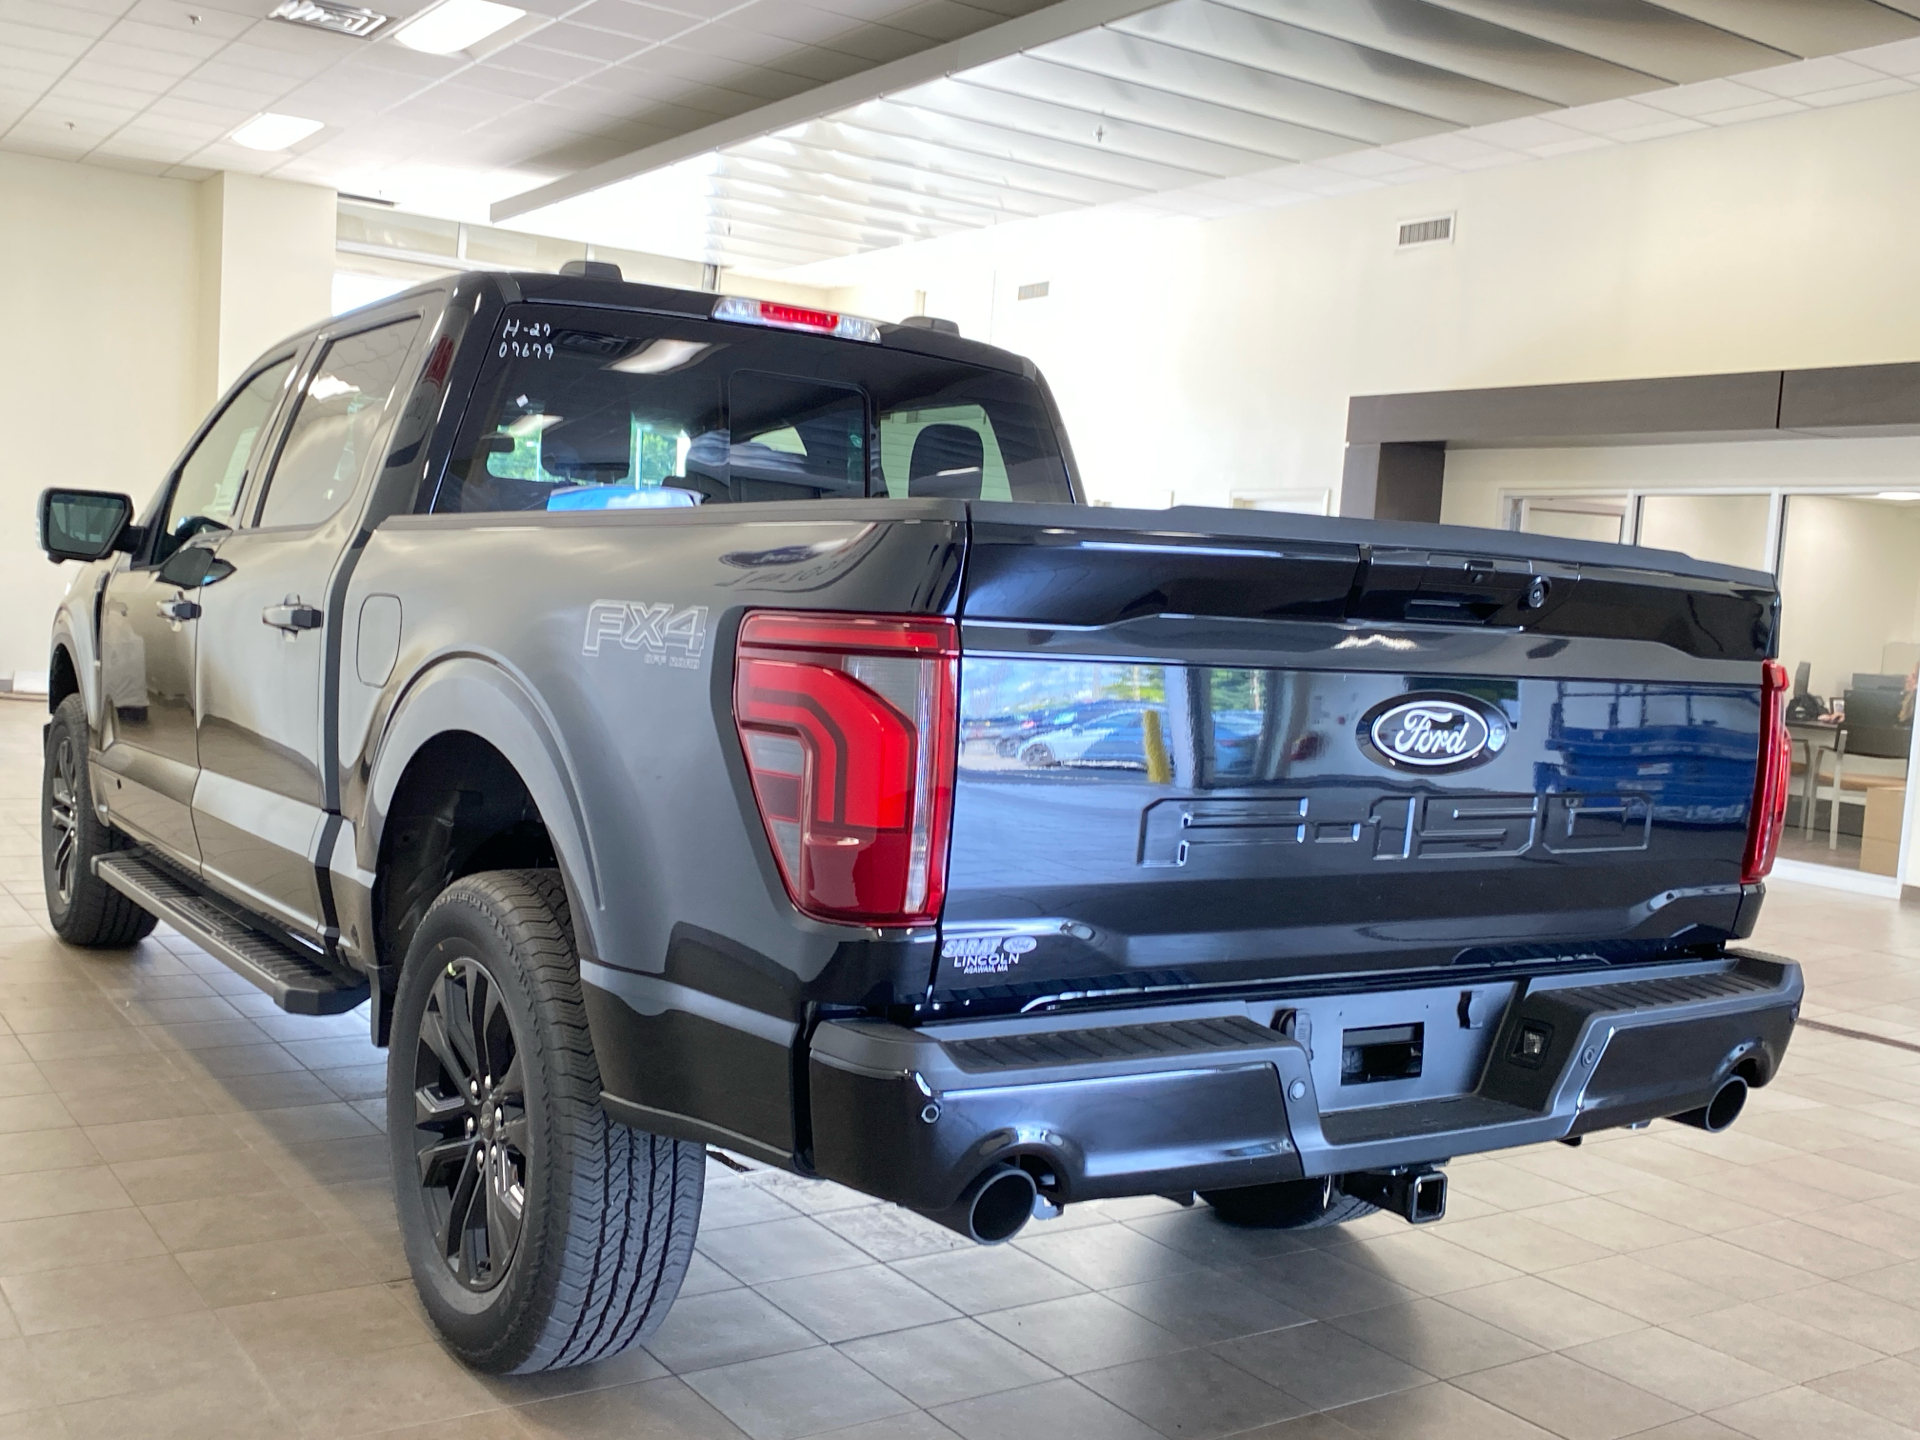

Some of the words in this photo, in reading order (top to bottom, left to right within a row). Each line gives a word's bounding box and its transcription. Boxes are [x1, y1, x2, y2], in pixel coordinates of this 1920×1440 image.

[582, 599, 709, 657] FX4
[1395, 709, 1469, 753] Ford
[1137, 796, 1652, 867] F-150
[954, 952, 1020, 968] LINCOLN
